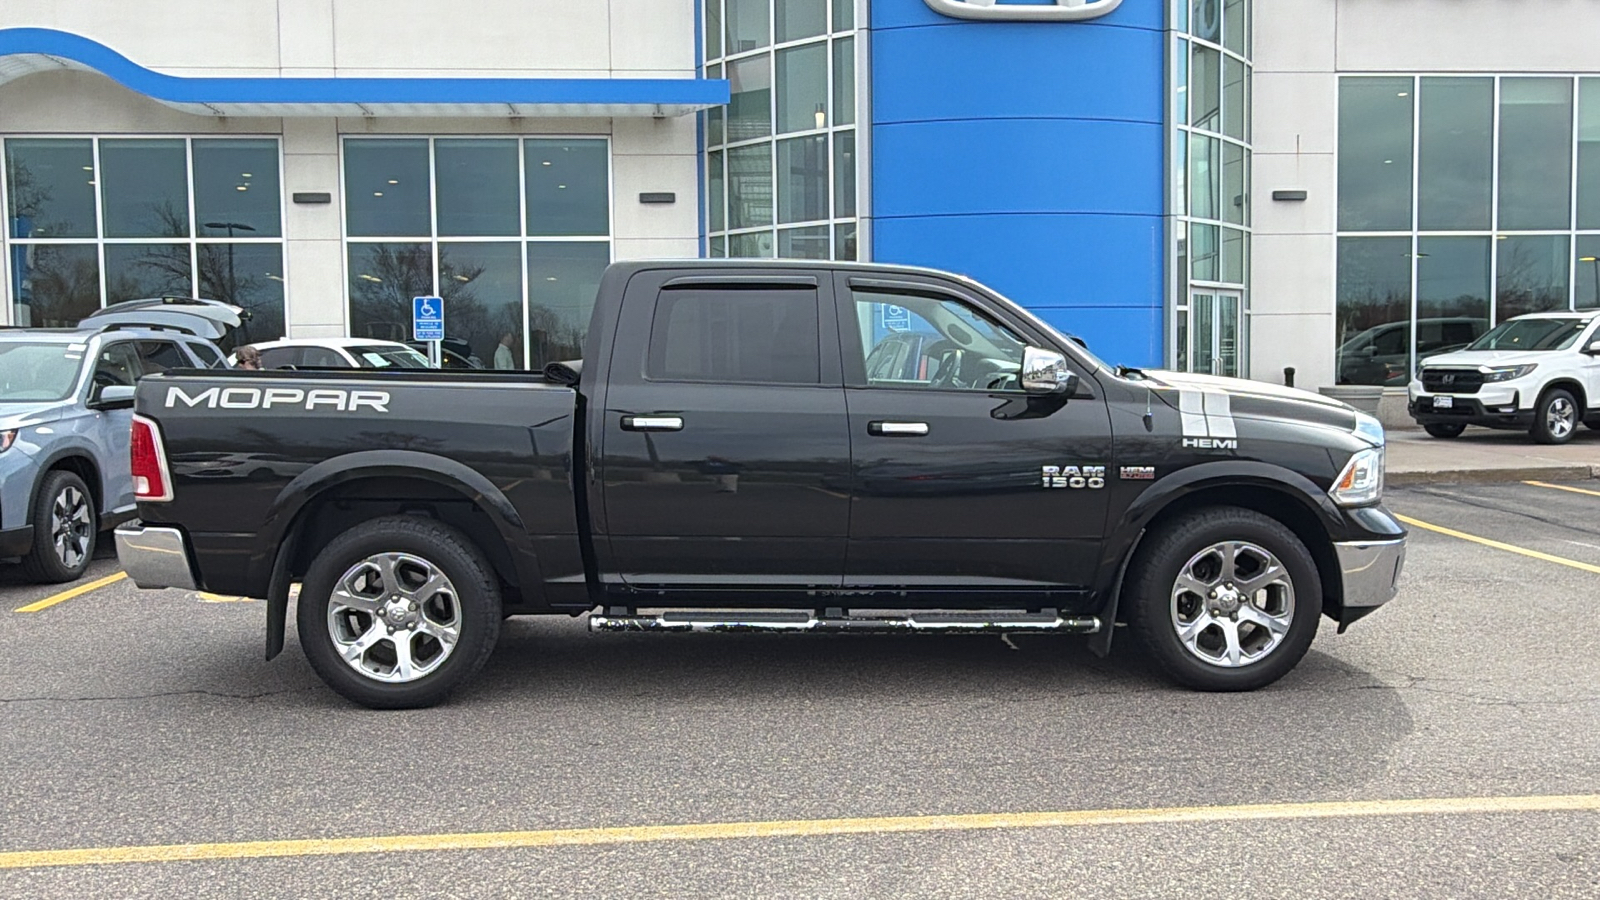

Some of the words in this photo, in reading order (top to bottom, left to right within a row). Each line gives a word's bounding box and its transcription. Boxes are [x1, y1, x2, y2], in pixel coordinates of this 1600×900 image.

[164, 386, 391, 413] MOPAR
[1182, 437, 1238, 450] HEMI
[1042, 465, 1106, 477] RAM
[1119, 466, 1155, 474] HEMI
[1042, 477, 1105, 489] 1500
